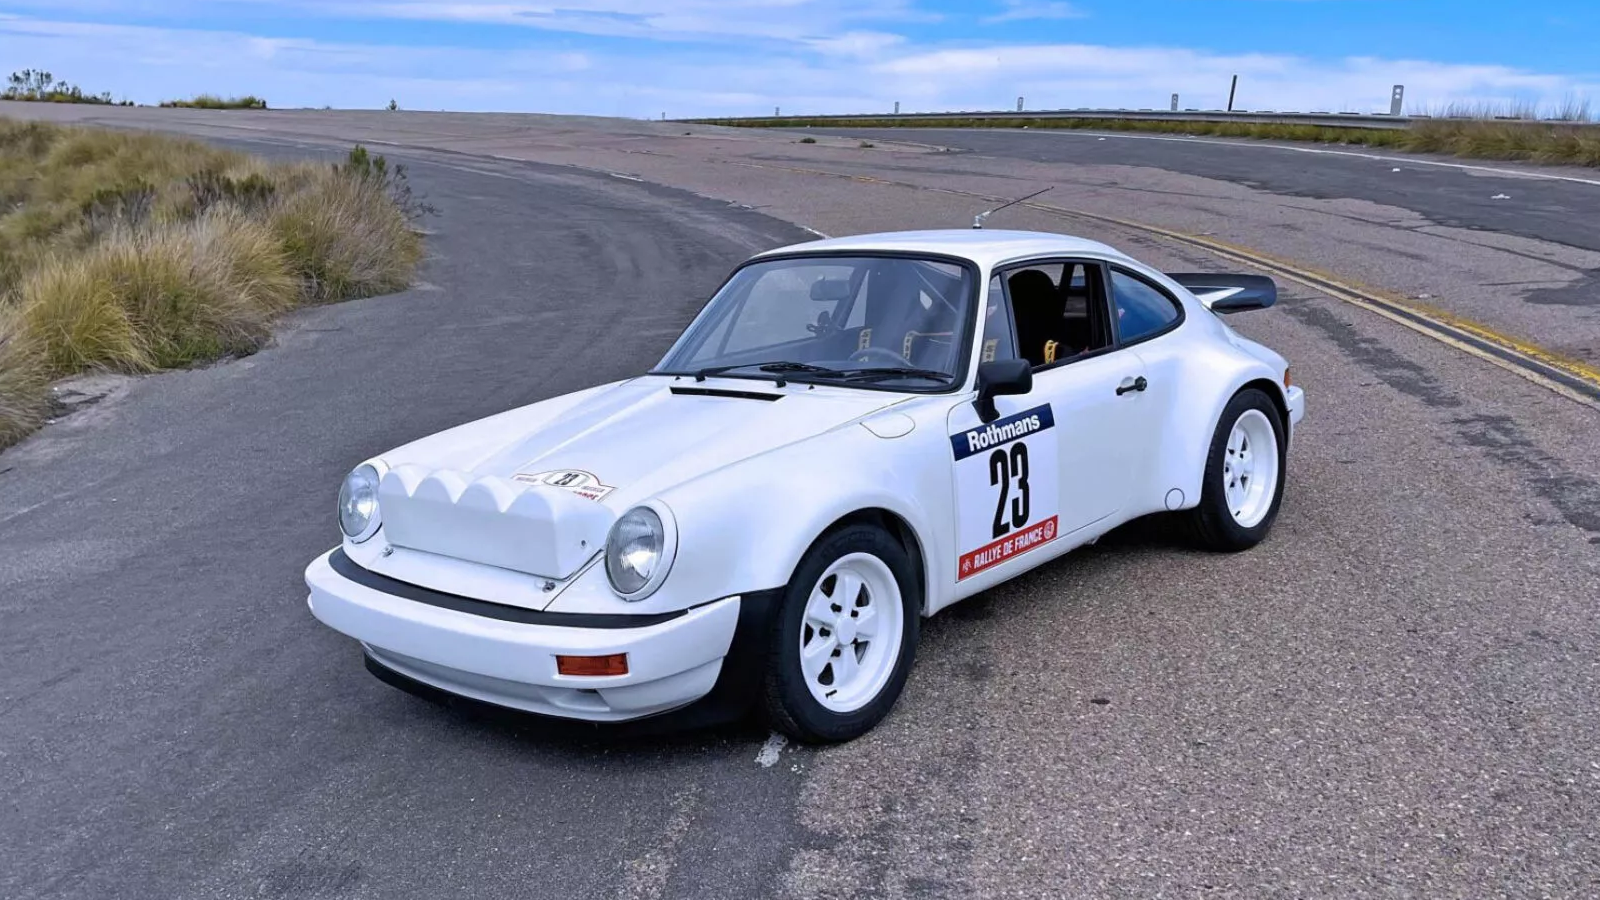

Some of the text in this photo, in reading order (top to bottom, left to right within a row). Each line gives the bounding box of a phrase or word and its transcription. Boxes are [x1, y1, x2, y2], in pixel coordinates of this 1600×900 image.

[967, 415, 1040, 452] Rothmans
[553, 473, 580, 486] 23
[989, 441, 1030, 539] 23
[974, 545, 1001, 569] RALLYE
[1003, 540, 1013, 556] DE
[1015, 527, 1043, 551] FRANCE
